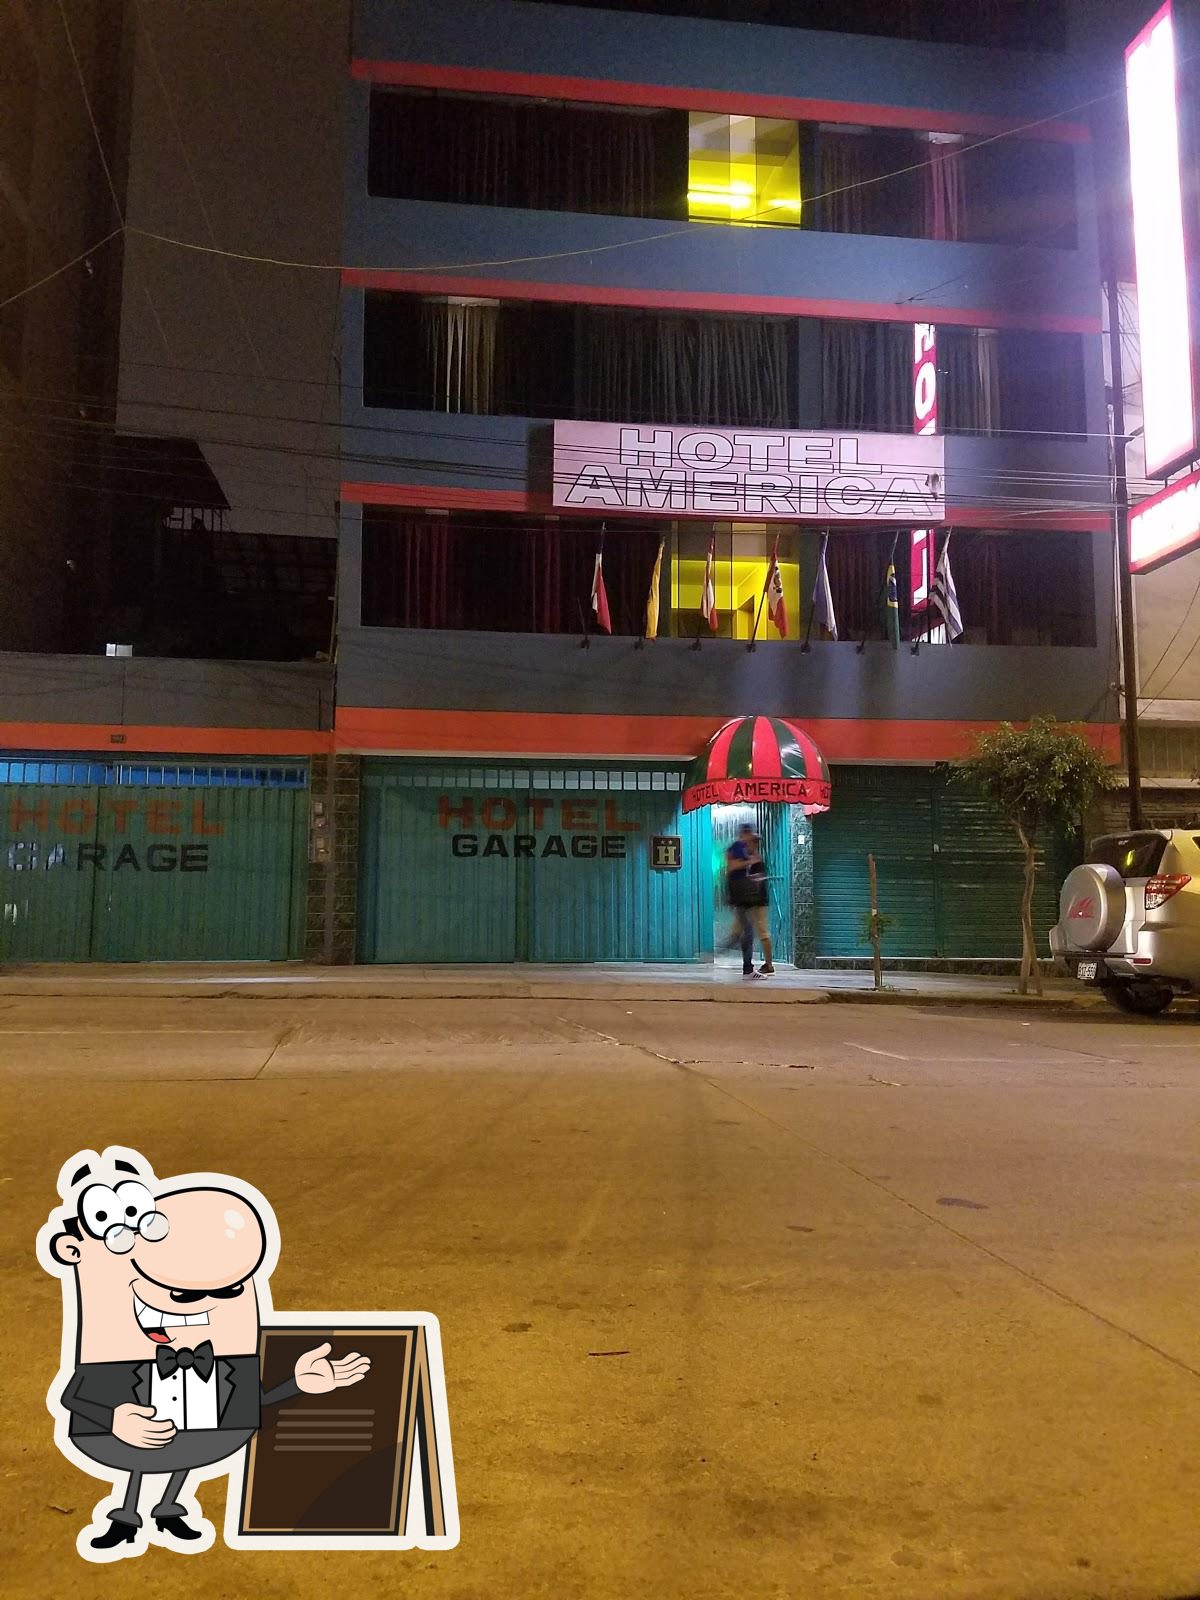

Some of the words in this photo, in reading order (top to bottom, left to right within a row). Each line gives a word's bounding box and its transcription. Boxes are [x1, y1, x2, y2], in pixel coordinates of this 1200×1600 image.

[620, 428, 882, 474] HOTEL
[565, 465, 932, 516] AMERICA
[693, 784, 718, 800] HOTEL
[734, 782, 807, 797] AMERICA
[9, 799, 224, 836] HOTEL
[438, 796, 640, 831] HOTEL
[452, 834, 626, 858] GARAGE
[657, 846, 676, 864] H
